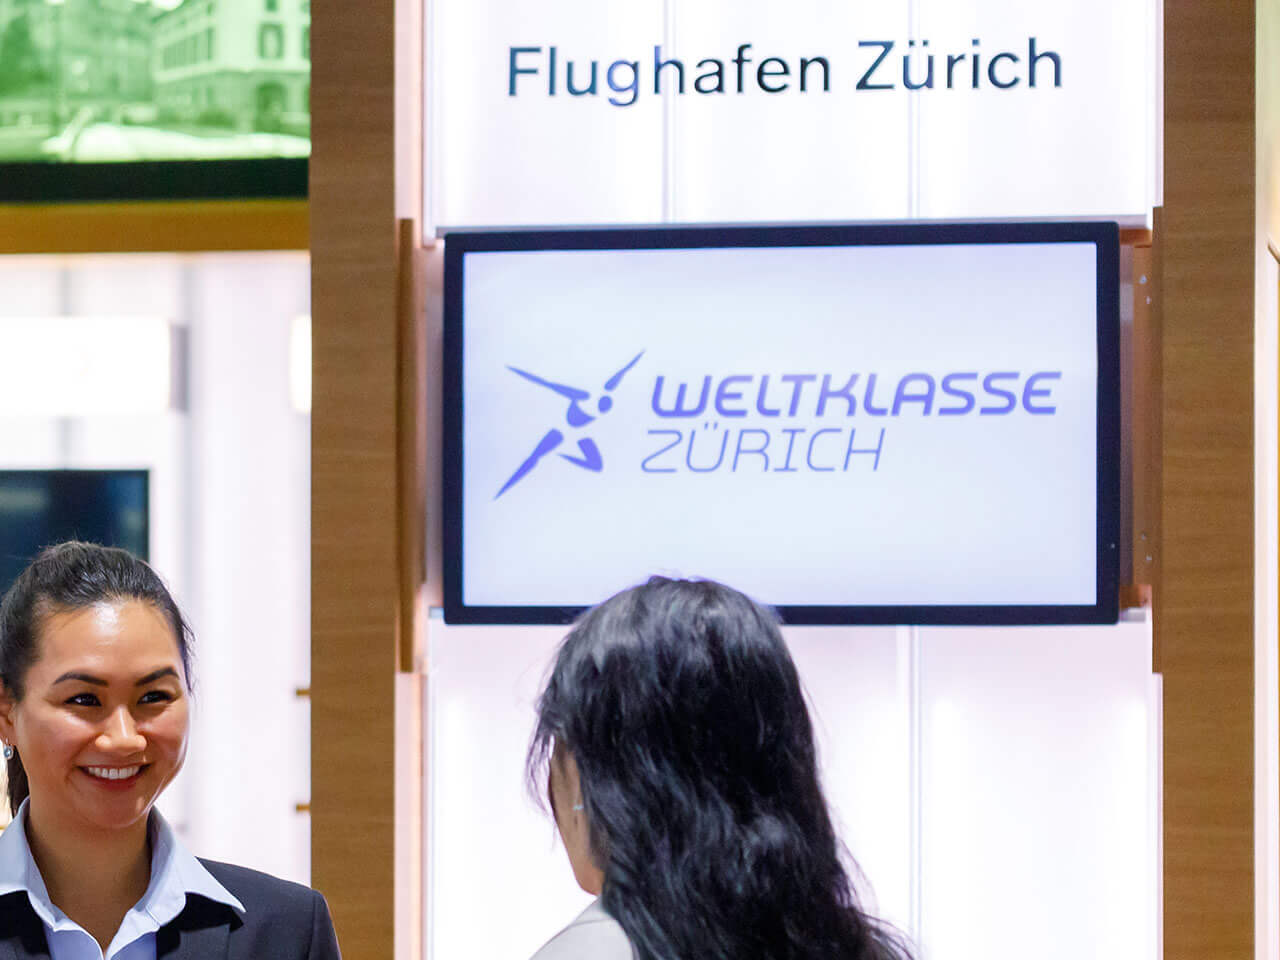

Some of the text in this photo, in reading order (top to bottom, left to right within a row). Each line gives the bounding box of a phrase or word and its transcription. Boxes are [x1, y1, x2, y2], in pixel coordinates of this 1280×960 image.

[508, 37, 1063, 107] Flughafen Zürich
[651, 371, 1062, 418] WELTKLASSE
[641, 422, 886, 474] ZÜRICH
